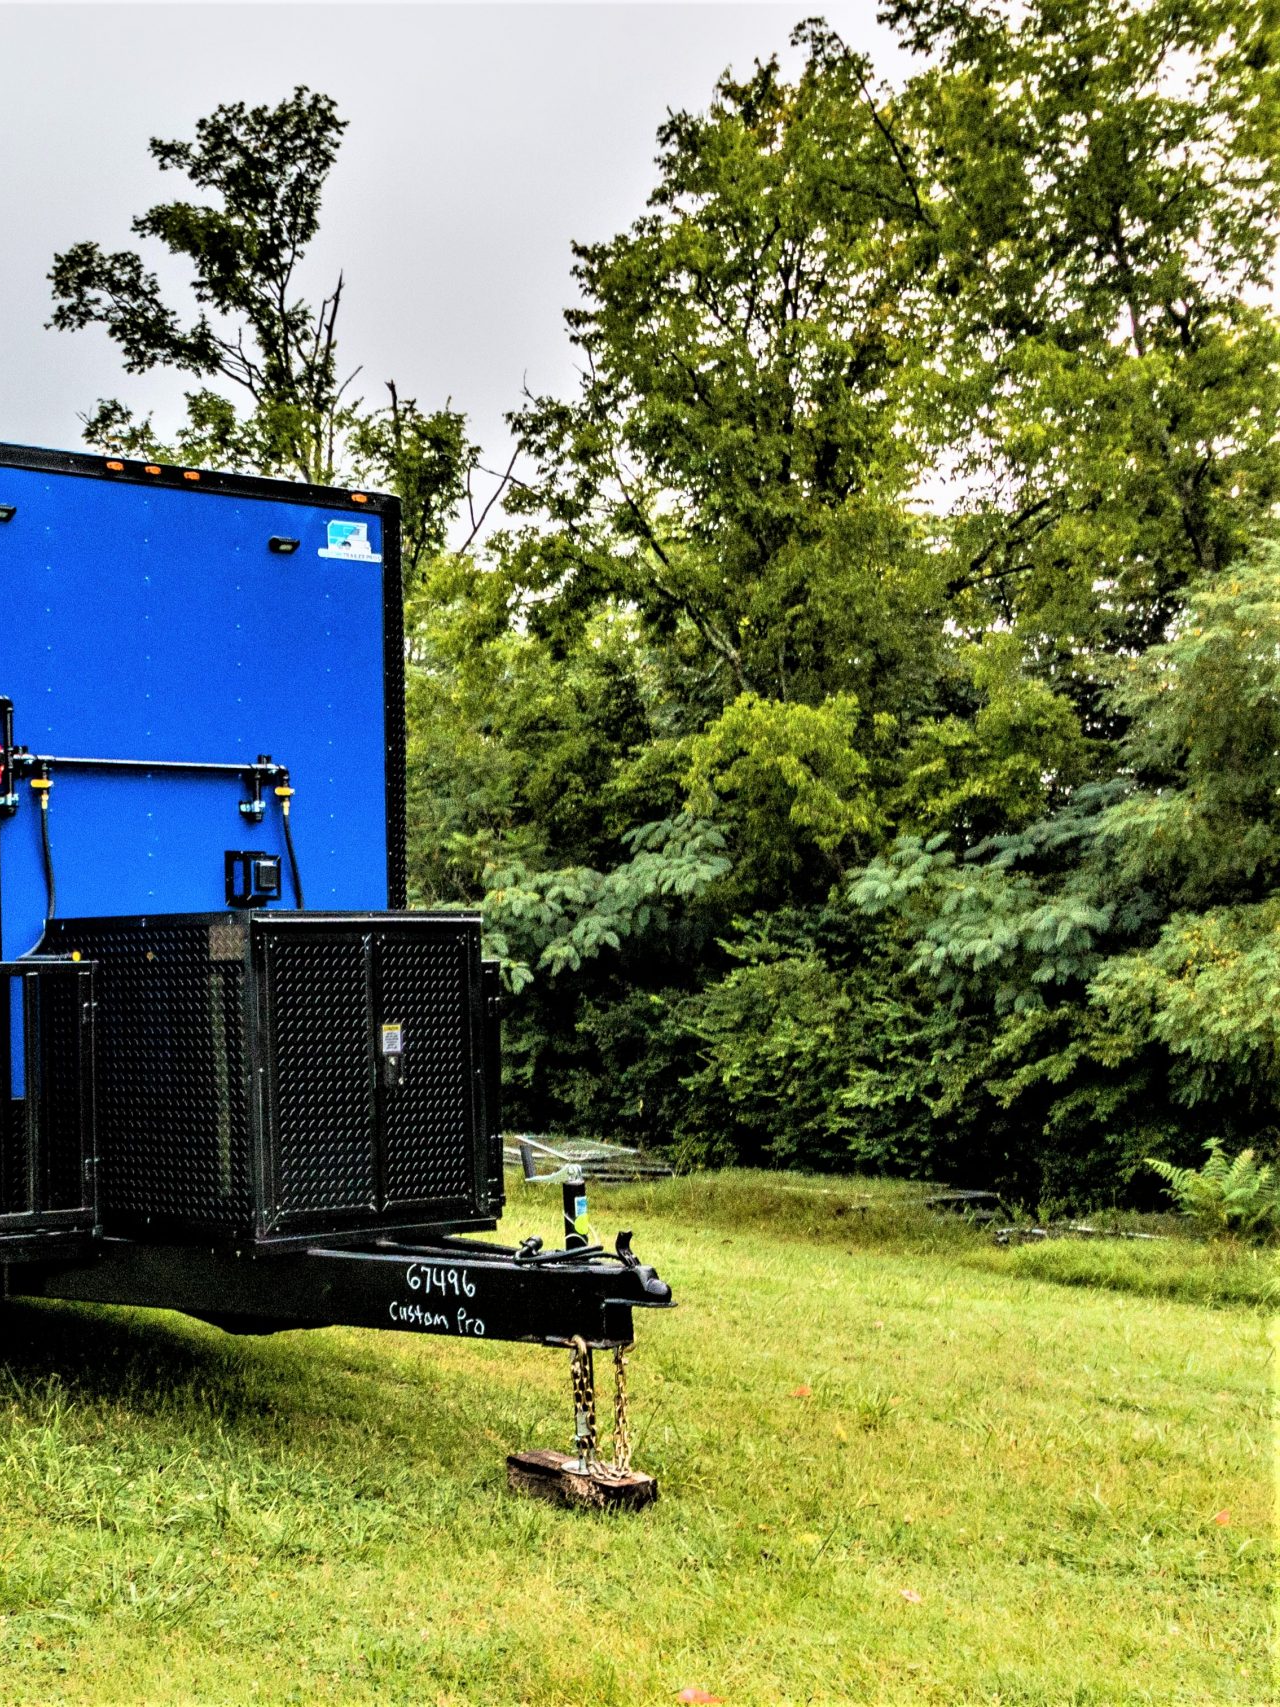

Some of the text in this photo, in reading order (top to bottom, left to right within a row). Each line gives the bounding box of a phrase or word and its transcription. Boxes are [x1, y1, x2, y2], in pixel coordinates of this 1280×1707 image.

[406, 1263, 476, 1297] 67496
[389, 1301, 485, 1335] Custom Pro
